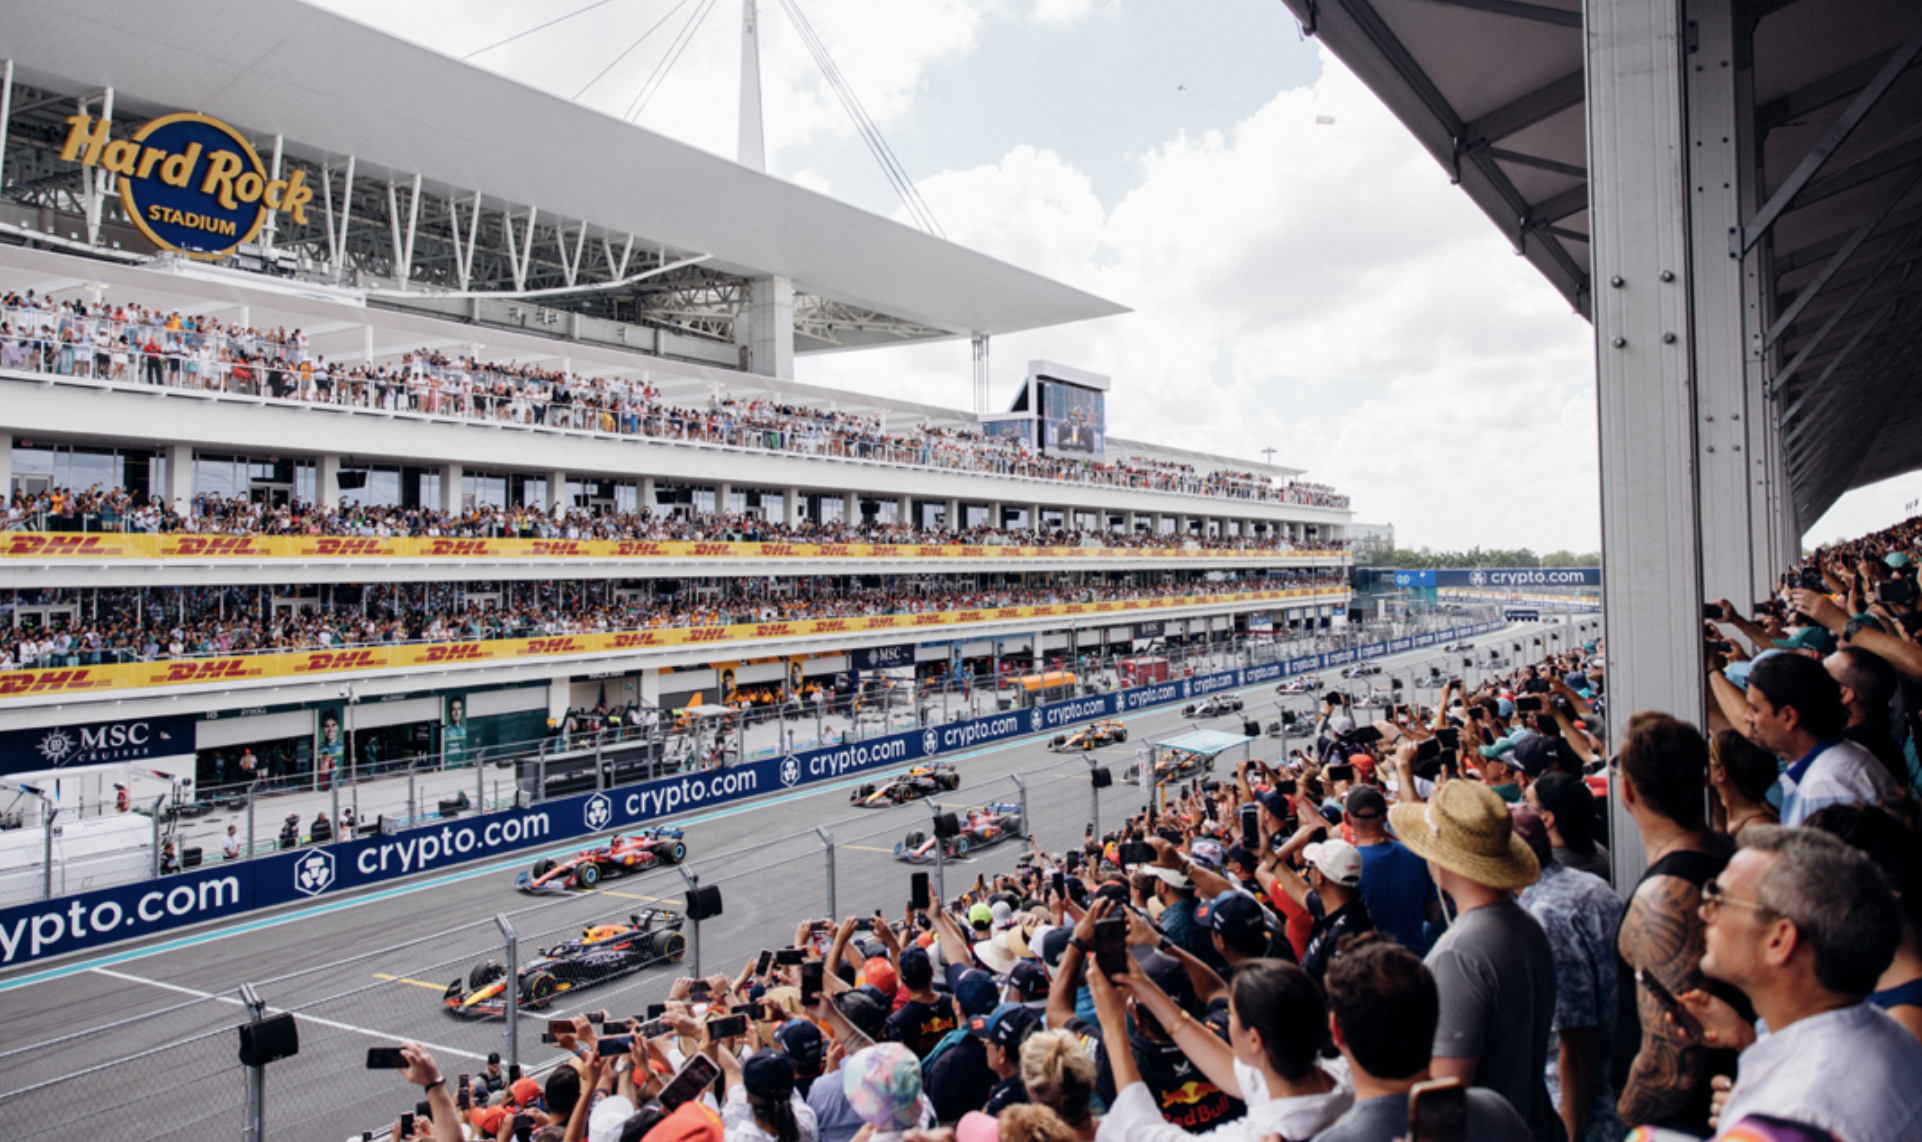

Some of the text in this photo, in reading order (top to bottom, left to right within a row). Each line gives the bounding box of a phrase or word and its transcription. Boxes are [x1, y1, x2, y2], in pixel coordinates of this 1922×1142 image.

[60, 113, 313, 225] Hard Rock
[148, 204, 237, 237] STADIUM
[9, 536, 104, 554] DHL
[177, 538, 257, 555] DHL
[315, 539, 383, 555] DHL
[432, 540, 490, 555] DHL
[532, 541, 581, 555] DHL
[618, 543, 660, 555] DHL
[694, 544, 731, 556] DHL
[760, 545, 795, 556] DHL
[1491, 570, 1585, 585] crypto.com
[689, 628, 727, 642] DHL
[756, 624, 791, 637] DHL
[815, 620, 846, 632] DHL
[527, 638, 575, 654] DHL
[613, 633, 657, 648] DHL
[307, 651, 376, 671] DHL
[426, 644, 484, 661] DHL
[167, 660, 248, 681] DHL
[0, 670, 95, 694] DHL
[1193, 674, 1233, 694] crypto.com
[1128, 685, 1176, 710] crypto.com
[1047, 699, 1105, 724] crypto.com
[79, 722, 150, 749] MSC
[944, 716, 1018, 747] crypto.com
[77, 747, 150, 763] CRUISES
[809, 739, 906, 776] crypto.com
[625, 769, 757, 816] crypto.com
[357, 812, 550, 874] crypto.com
[0, 876, 240, 962] ypto.com
[1197, 1092, 1231, 1123] Bull
